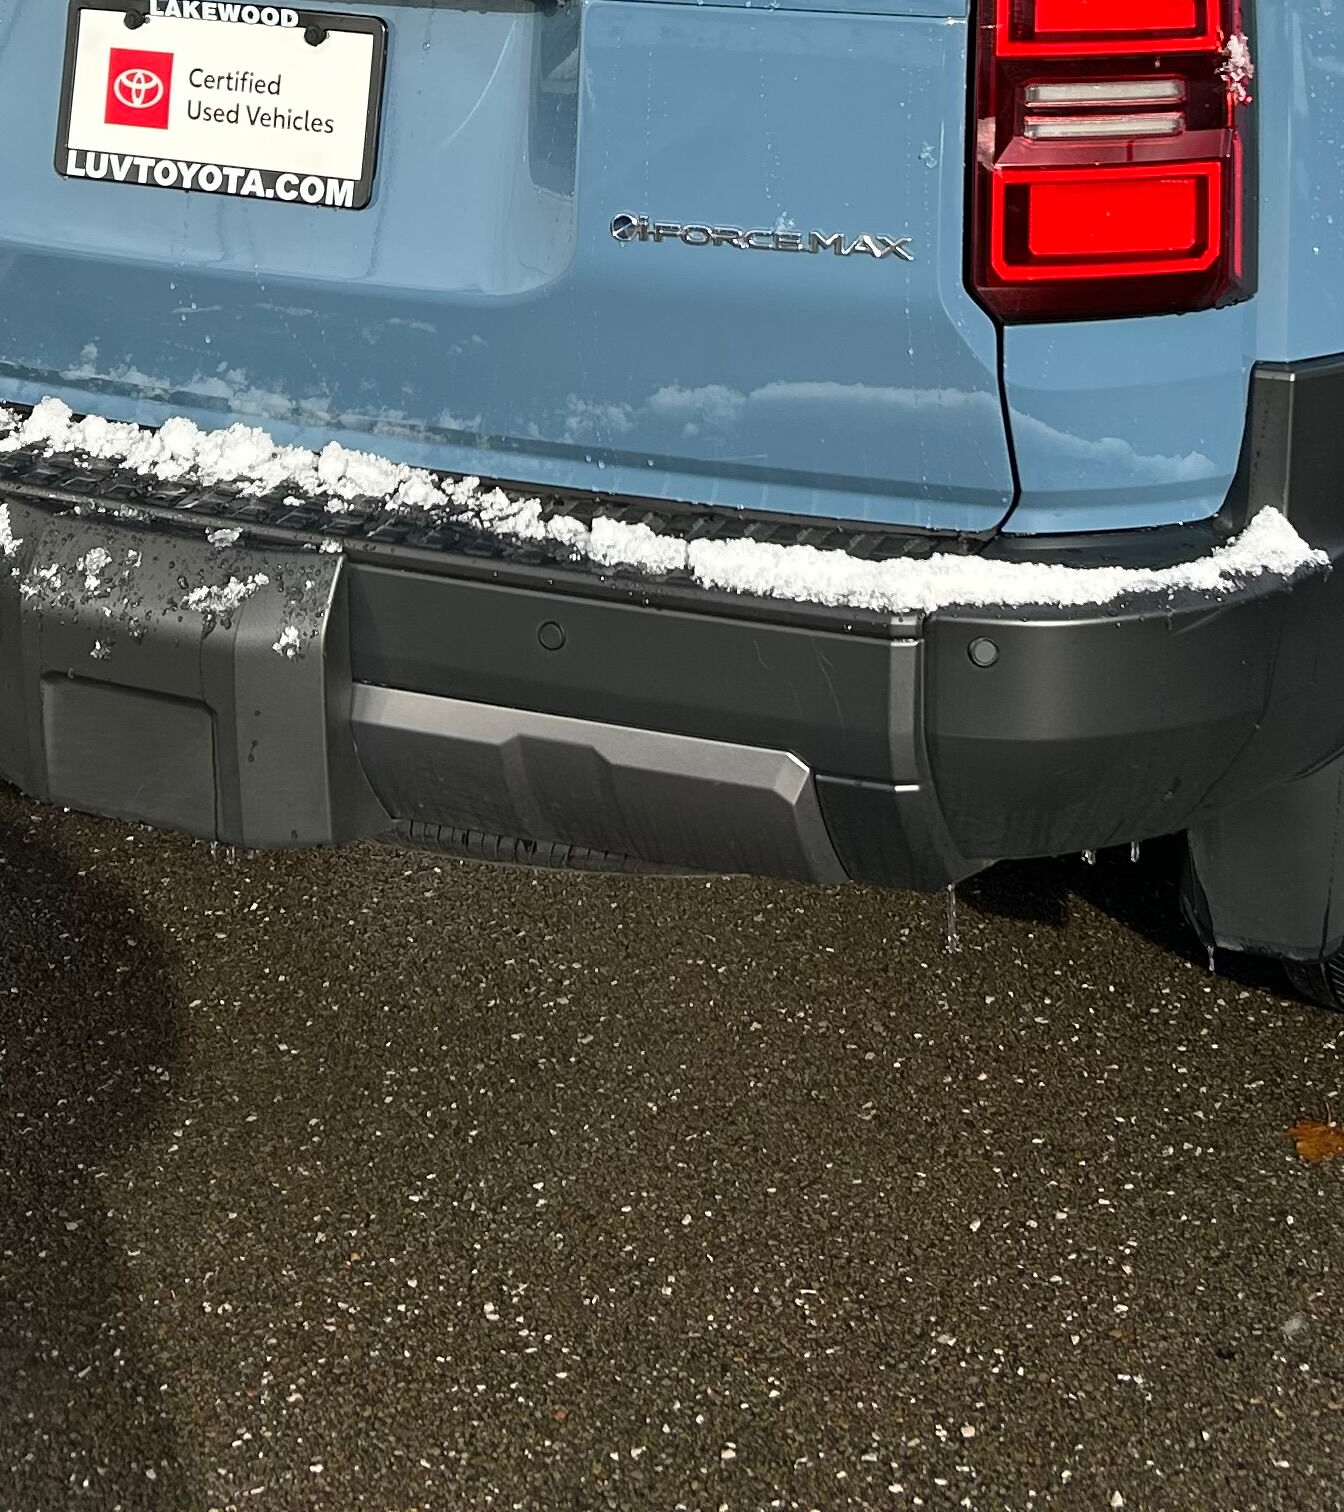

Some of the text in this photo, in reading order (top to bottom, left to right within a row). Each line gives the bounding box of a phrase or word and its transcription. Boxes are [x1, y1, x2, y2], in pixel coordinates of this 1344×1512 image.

[189, 68, 281, 95] Certified
[187, 100, 335, 134] Used Vehicles
[66, 149, 355, 208] LUVTOYOTA.COM
